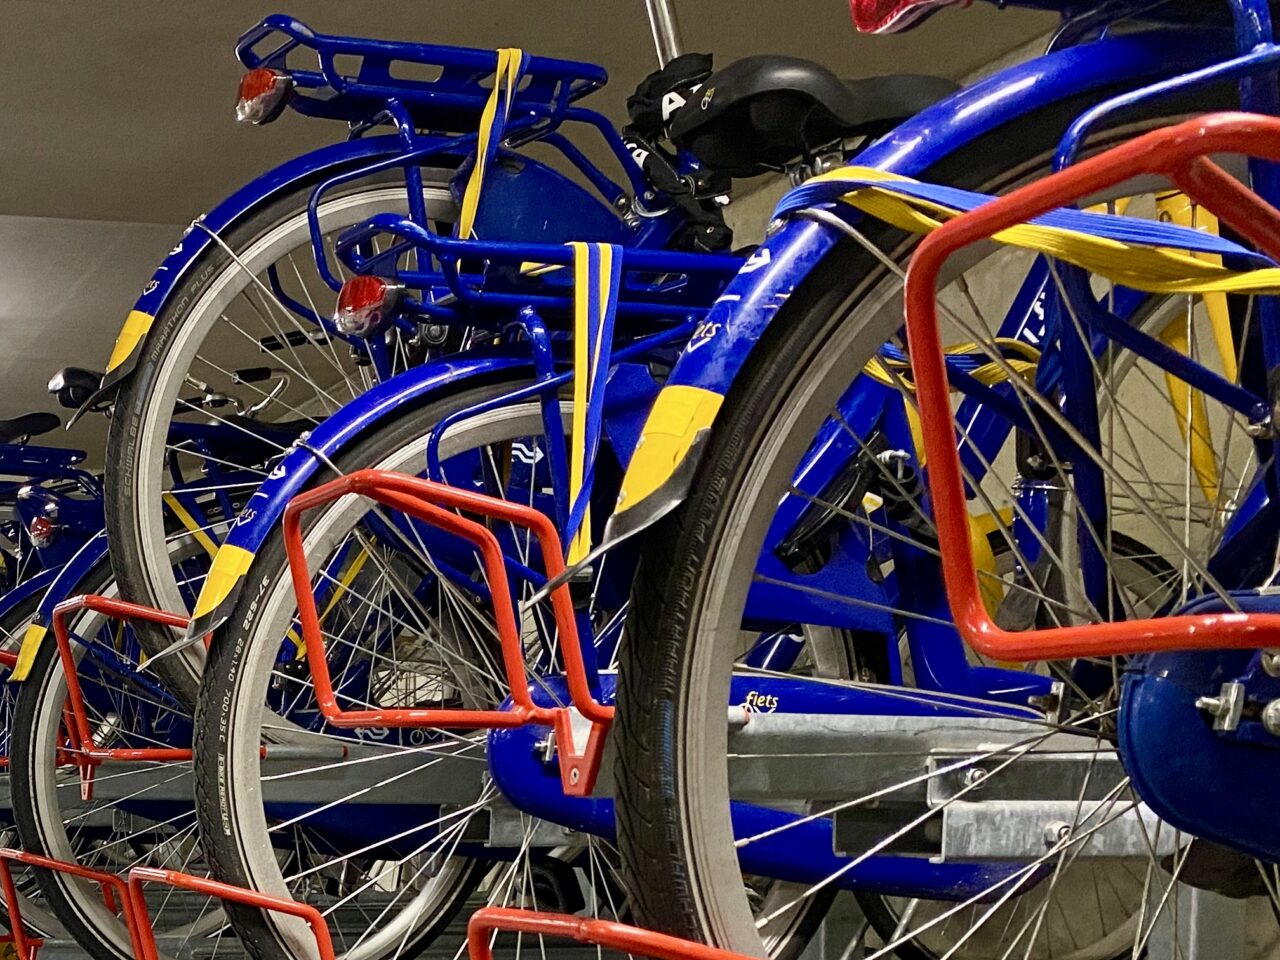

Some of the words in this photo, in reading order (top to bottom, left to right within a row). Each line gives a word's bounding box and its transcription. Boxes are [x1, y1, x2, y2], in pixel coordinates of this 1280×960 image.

[151, 296, 190, 361] MARATHON
[190, 263, 215, 295] PLUS
[746, 691, 779, 708] fiets
